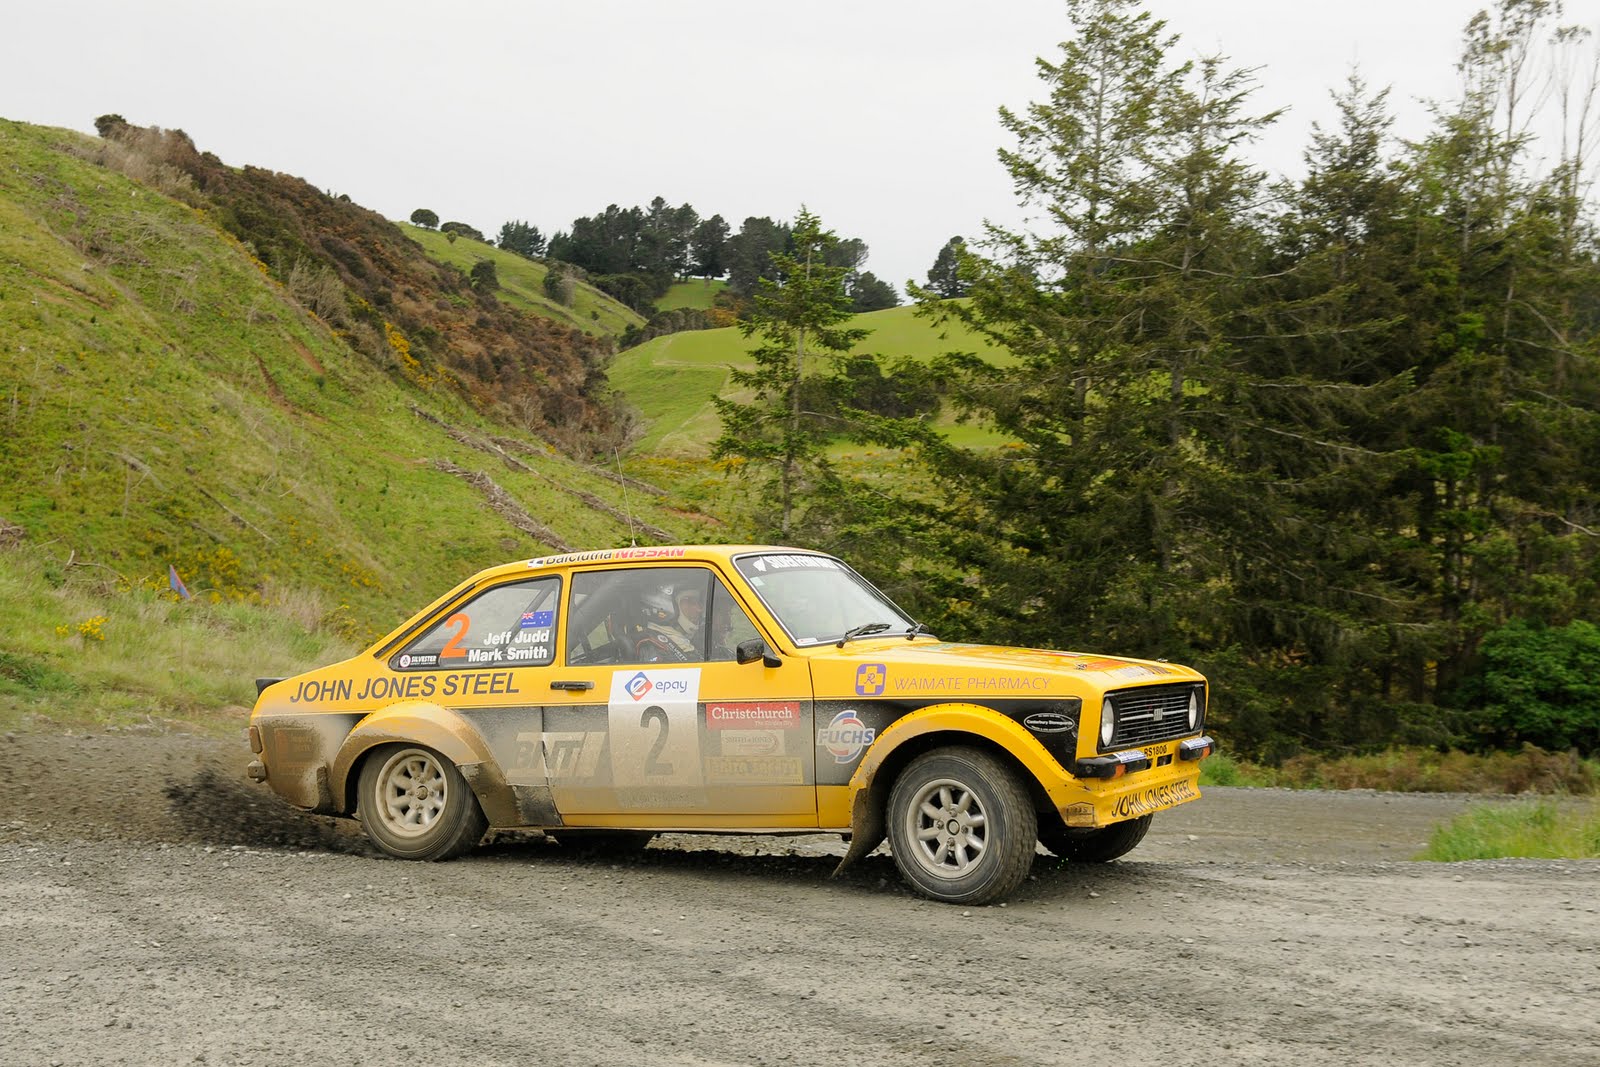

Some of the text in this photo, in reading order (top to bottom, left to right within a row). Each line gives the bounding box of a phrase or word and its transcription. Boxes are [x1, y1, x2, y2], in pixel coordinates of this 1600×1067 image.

[615, 548, 685, 559] NISSAN
[440, 613, 471, 658] 2
[483, 629, 550, 646] Jeff Judd
[411, 655, 437, 663] SILVESTER
[468, 646, 548, 663] Mark Smith
[289, 672, 520, 702] JOHN JONES STEEL
[655, 680, 688, 693] epay
[894, 677, 1052, 691] WAIMATE PHARMACY
[711, 706, 793, 719] Christchurch
[640, 705, 674, 776] 2
[818, 729, 875, 745] FUCHS
[1111, 779, 1196, 818] JOHN JONES STEEL
